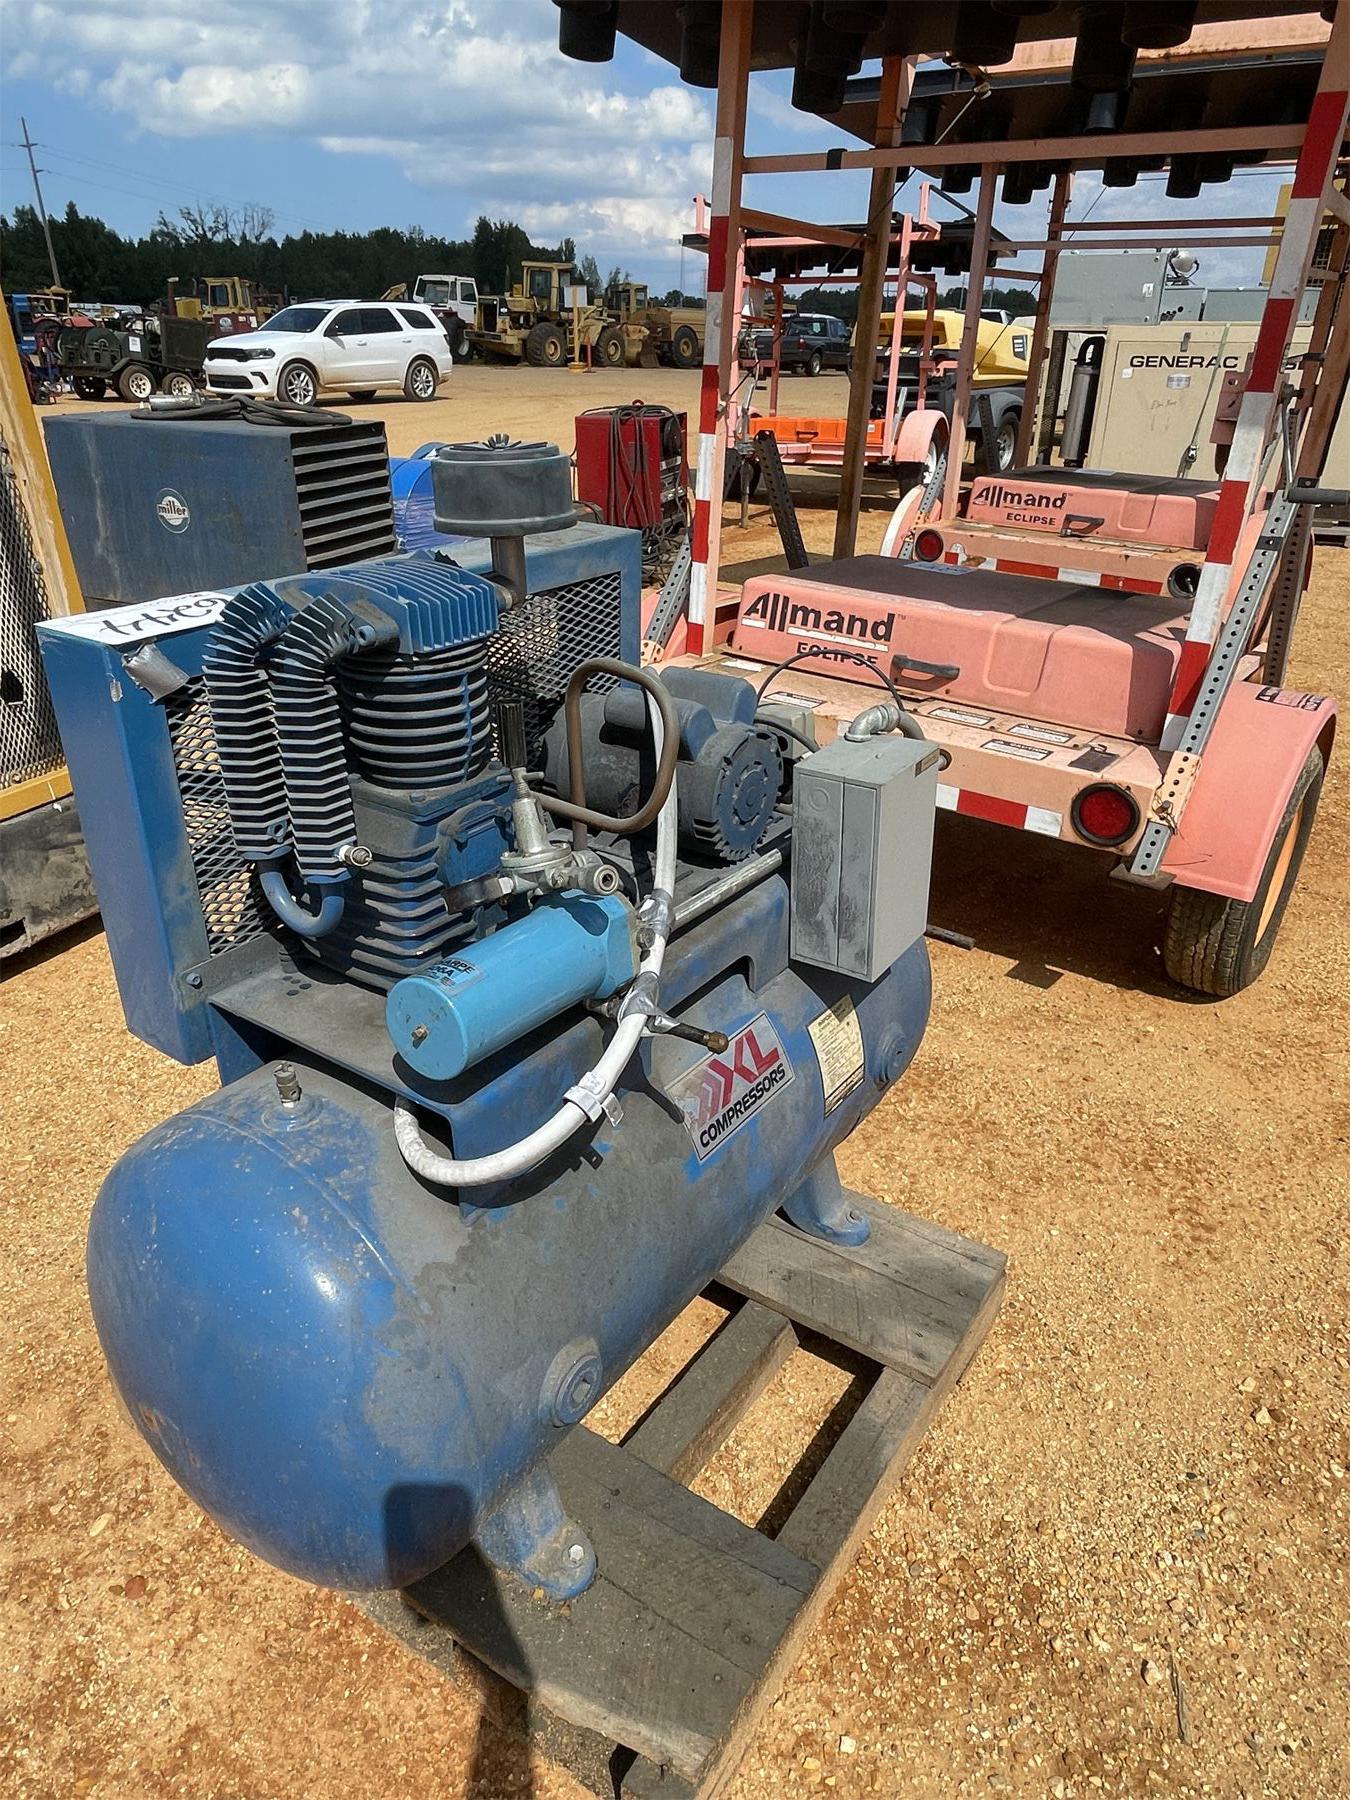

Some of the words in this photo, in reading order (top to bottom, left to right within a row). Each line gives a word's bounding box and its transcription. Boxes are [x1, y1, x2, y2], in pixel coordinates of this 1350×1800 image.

[1129, 355, 1239, 369] GENERAC
[158, 500, 186, 515] miller
[974, 485, 1068, 509] Allmand
[1006, 512, 1057, 526] ECLIPSE
[743, 592, 896, 643] Allmand
[707, 1028, 781, 1110] XL
[699, 1062, 786, 1149] COMPRESSORS
